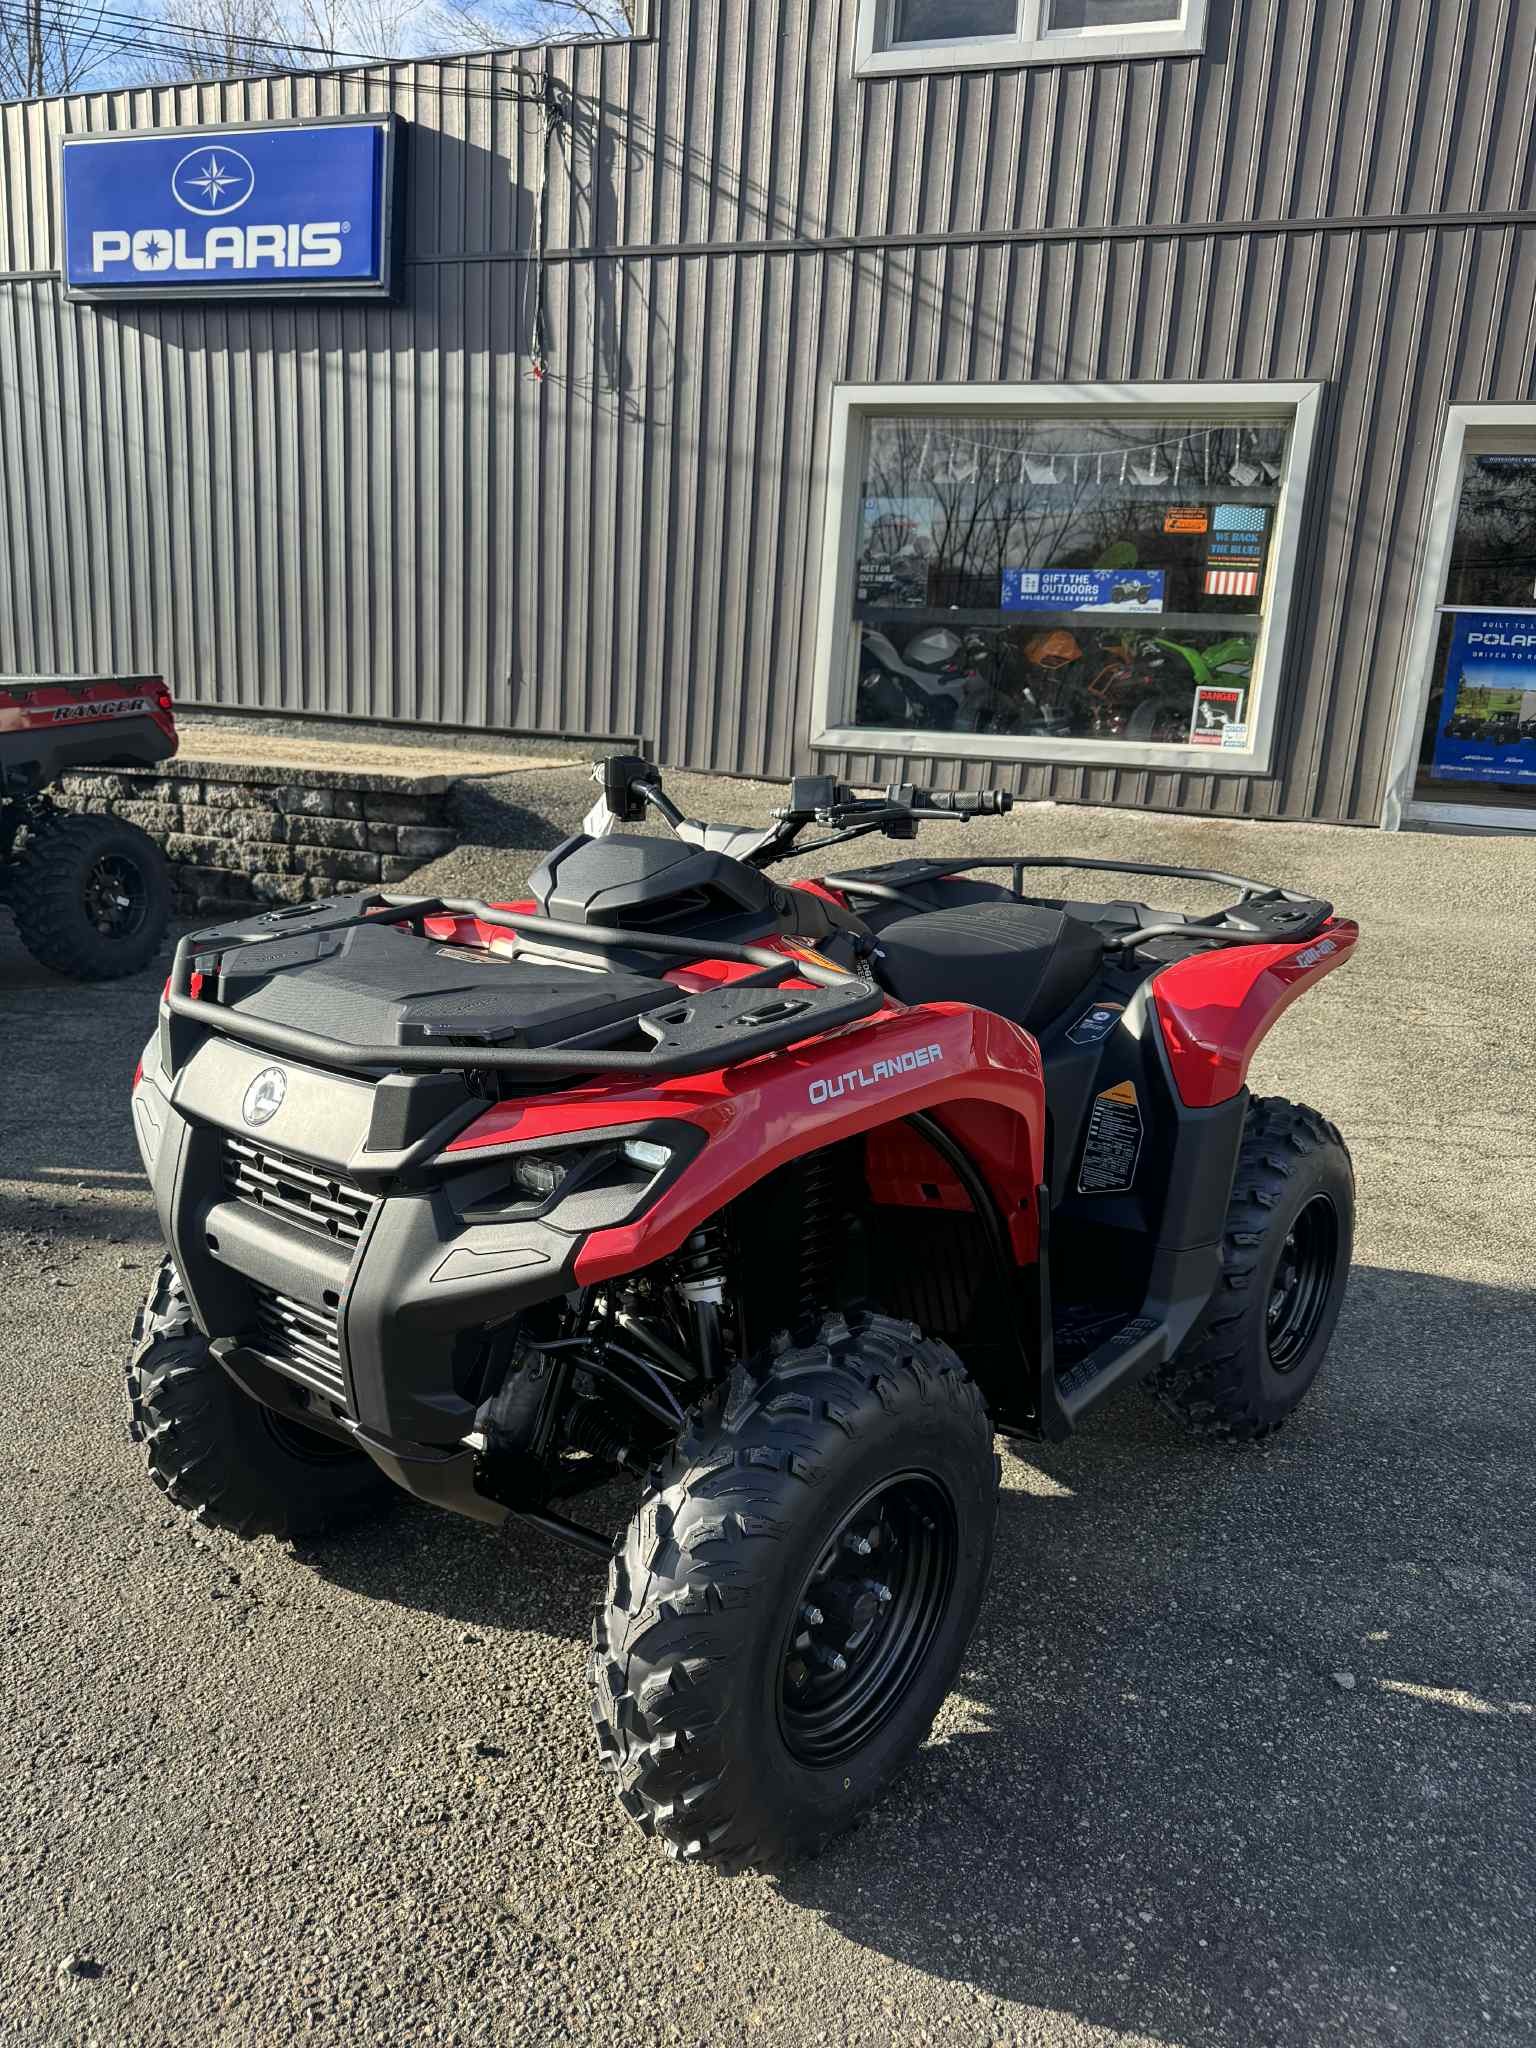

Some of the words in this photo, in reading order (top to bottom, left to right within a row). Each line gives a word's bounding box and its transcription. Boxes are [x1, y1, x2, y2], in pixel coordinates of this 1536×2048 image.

[92, 221, 343, 273] POLARIS
[1041, 574, 1067, 584] GIFT
[1068, 574, 1089, 585] THE
[1041, 584, 1100, 595] OUTDOORS
[1200, 690, 1238, 702] DANGER
[54, 698, 146, 721] RANGER
[808, 1042, 944, 1106] OUTLANDER
